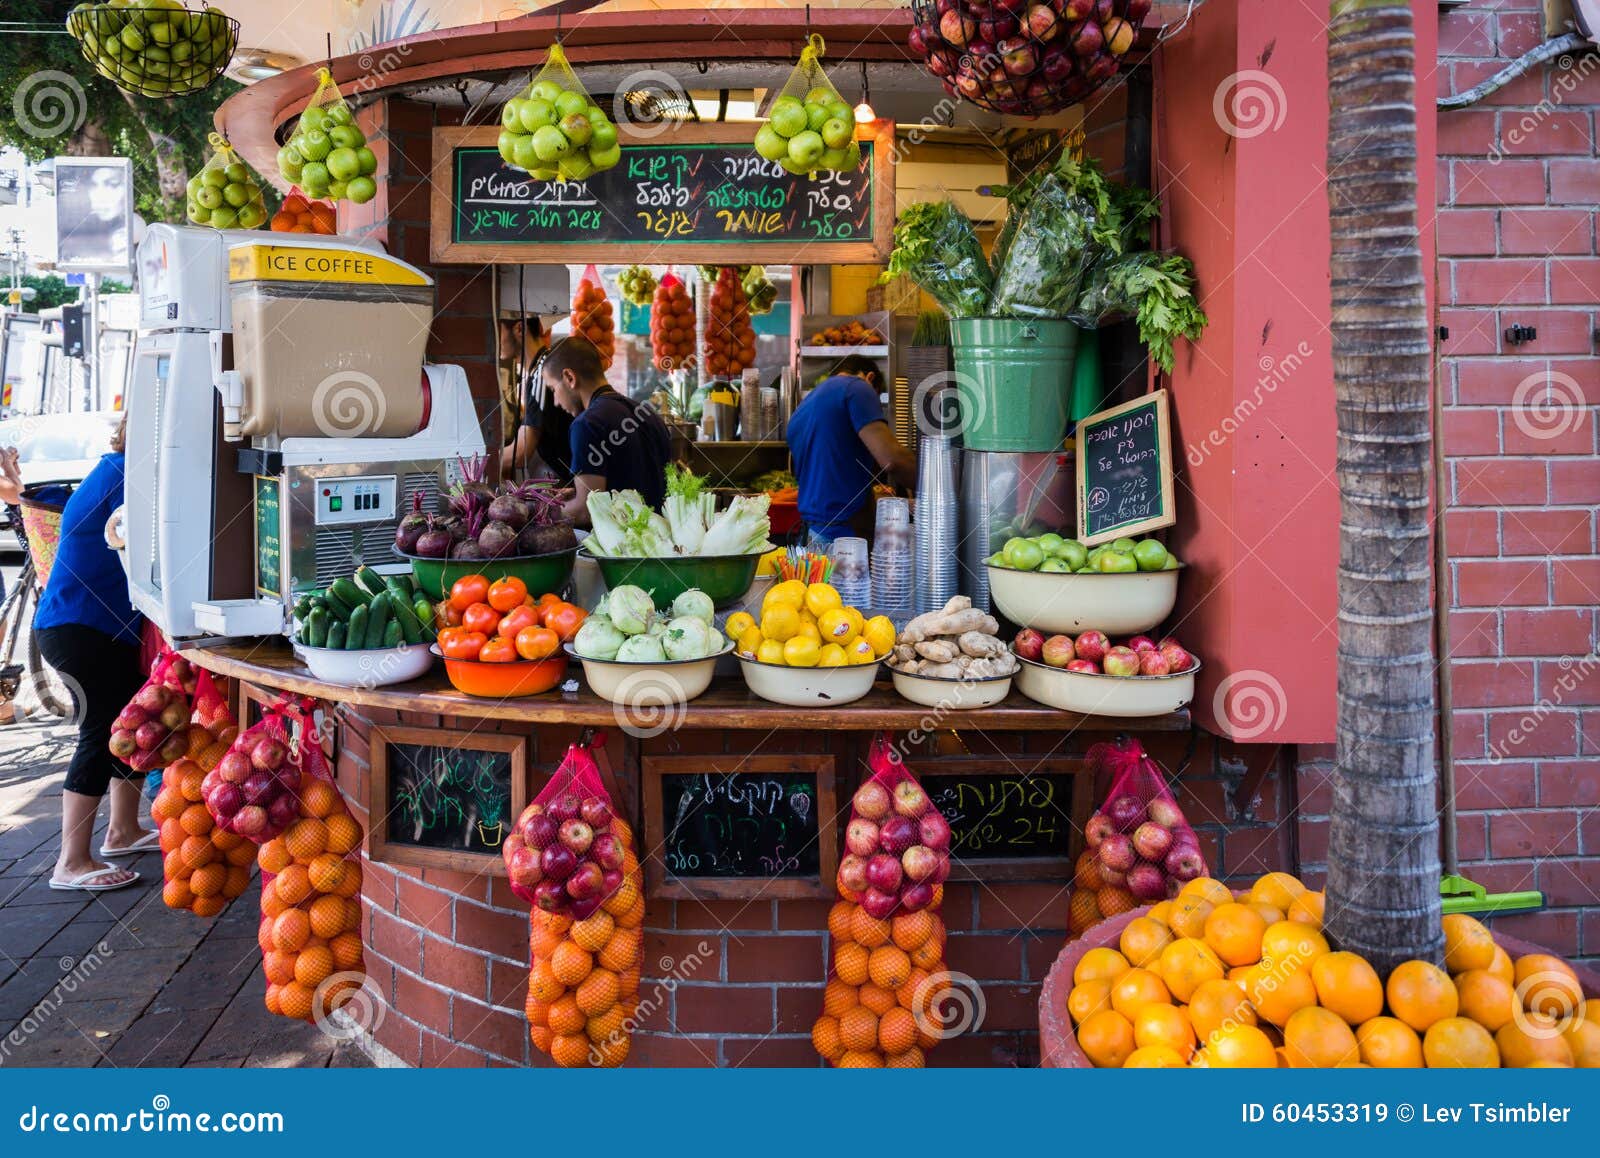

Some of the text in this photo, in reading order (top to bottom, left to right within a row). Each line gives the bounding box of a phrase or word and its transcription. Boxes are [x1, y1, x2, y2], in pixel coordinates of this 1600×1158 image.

[628, 155, 688, 190] קישוא
[470, 173, 530, 199] סחוטים
[636, 181, 689, 207] פילפל
[807, 186, 852, 217] סלק
[567, 208, 602, 229] עשב
[715, 209, 785, 233] שומר
[801, 212, 852, 238] סלרי
[267, 255, 297, 271] ICE
[304, 257, 374, 275] COFFEE
[1117, 438, 1135, 454] עם
[1098, 456, 1113, 472] של
[956, 778, 1055, 817] פתוח
[1007, 815, 1060, 845] 24
